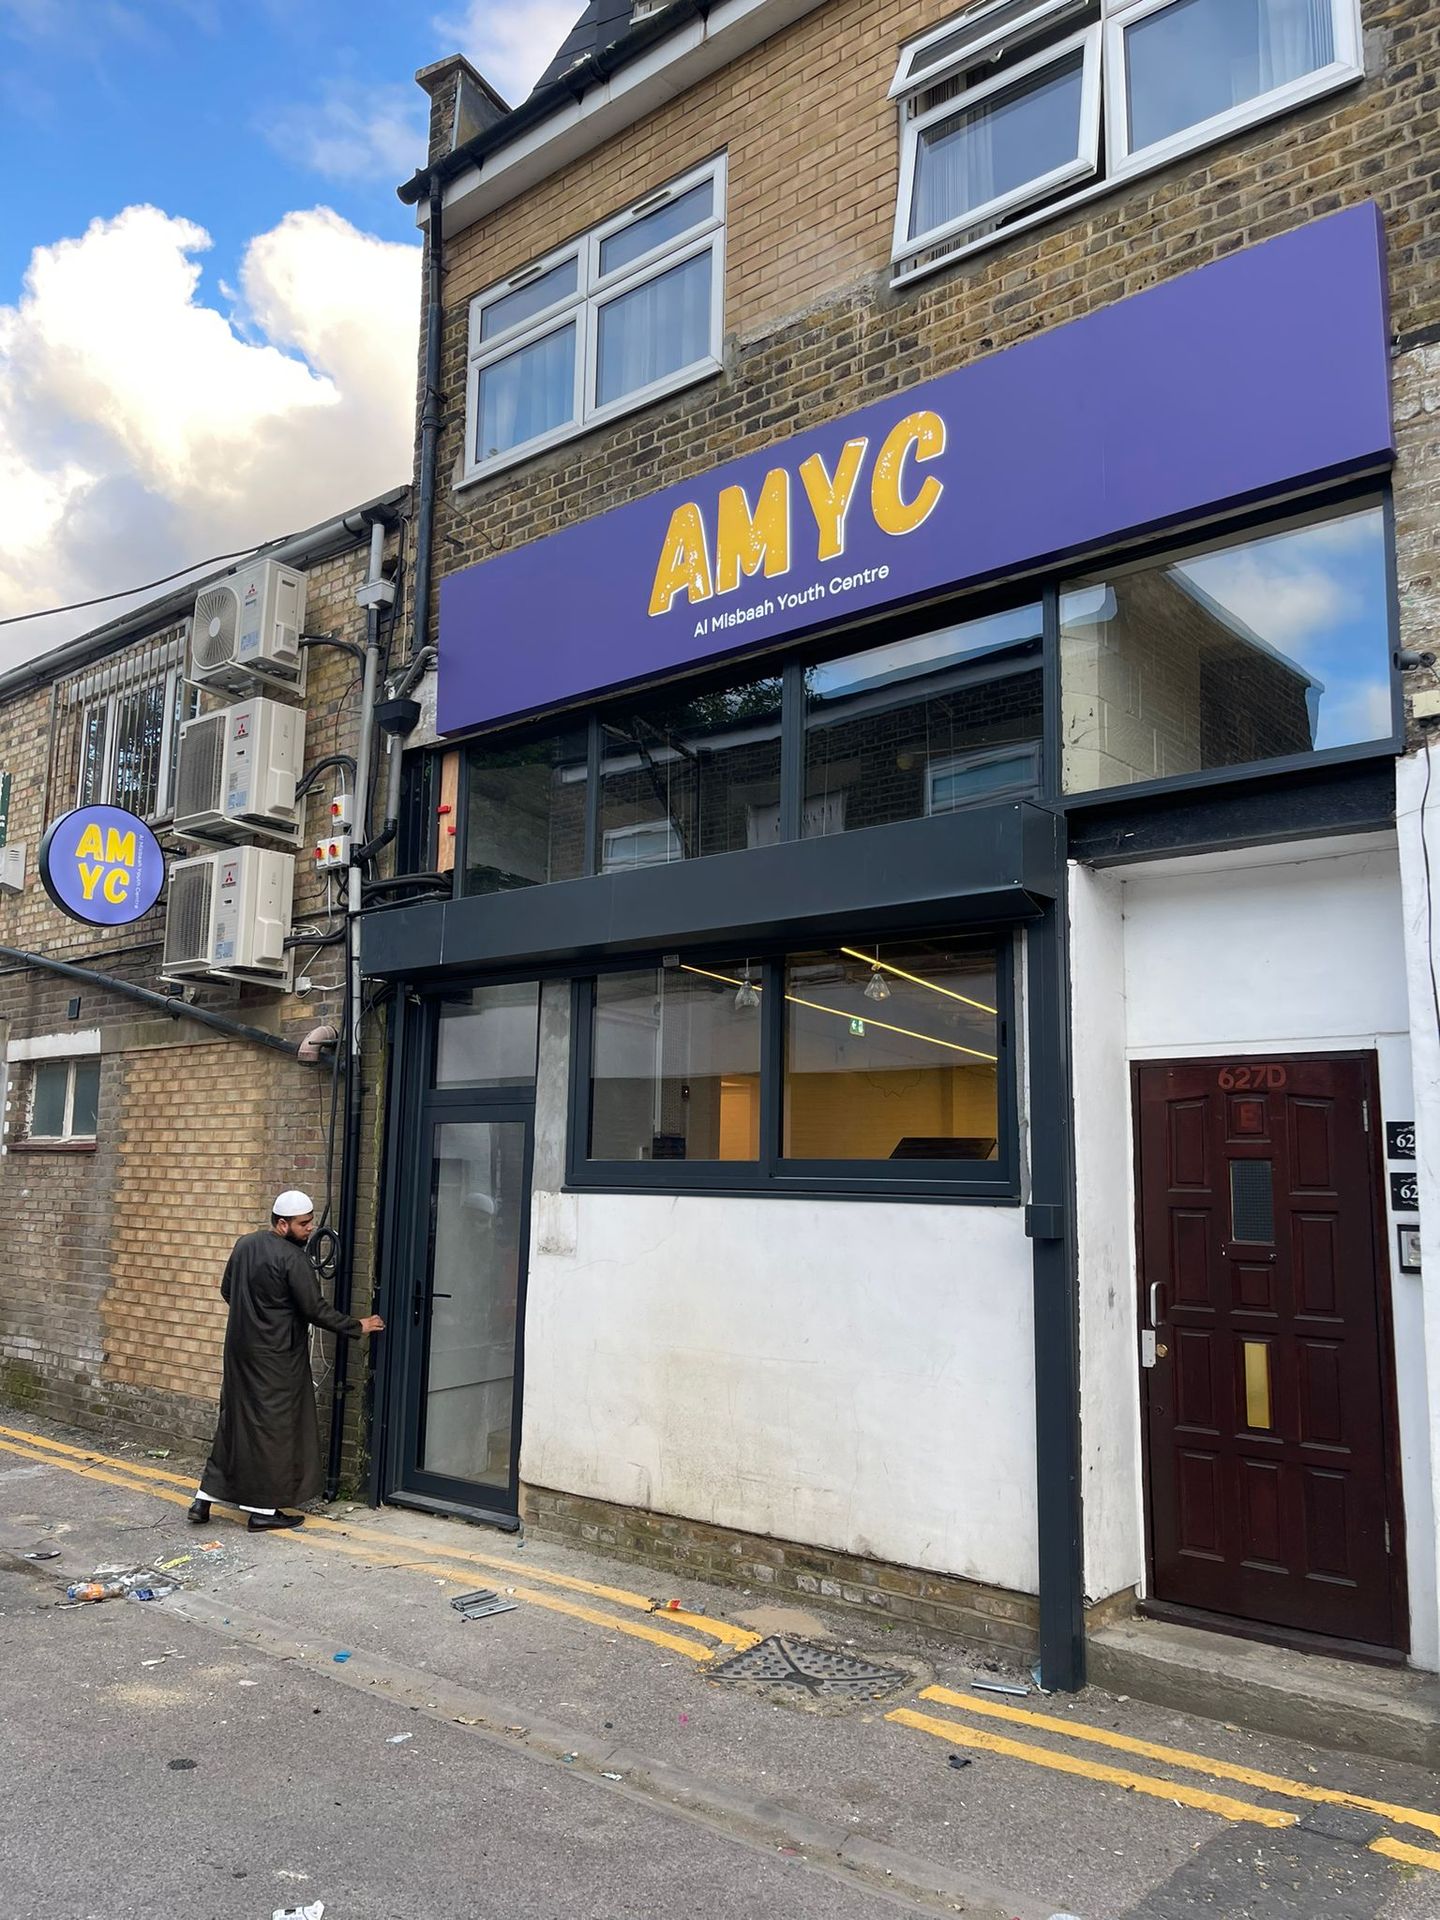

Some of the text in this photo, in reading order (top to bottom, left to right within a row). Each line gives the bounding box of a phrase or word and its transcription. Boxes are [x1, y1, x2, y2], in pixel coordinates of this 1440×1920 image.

[648, 410, 946, 616] AMYC
[693, 564, 890, 639] Al Misbaah Youth Centre
[75, 824, 136, 867] AM
[78, 862, 129, 904] YC
[1217, 1064, 1287, 1090] 627D
[1396, 1133, 1416, 1148] 62
[1400, 1184, 1419, 1199] 62
